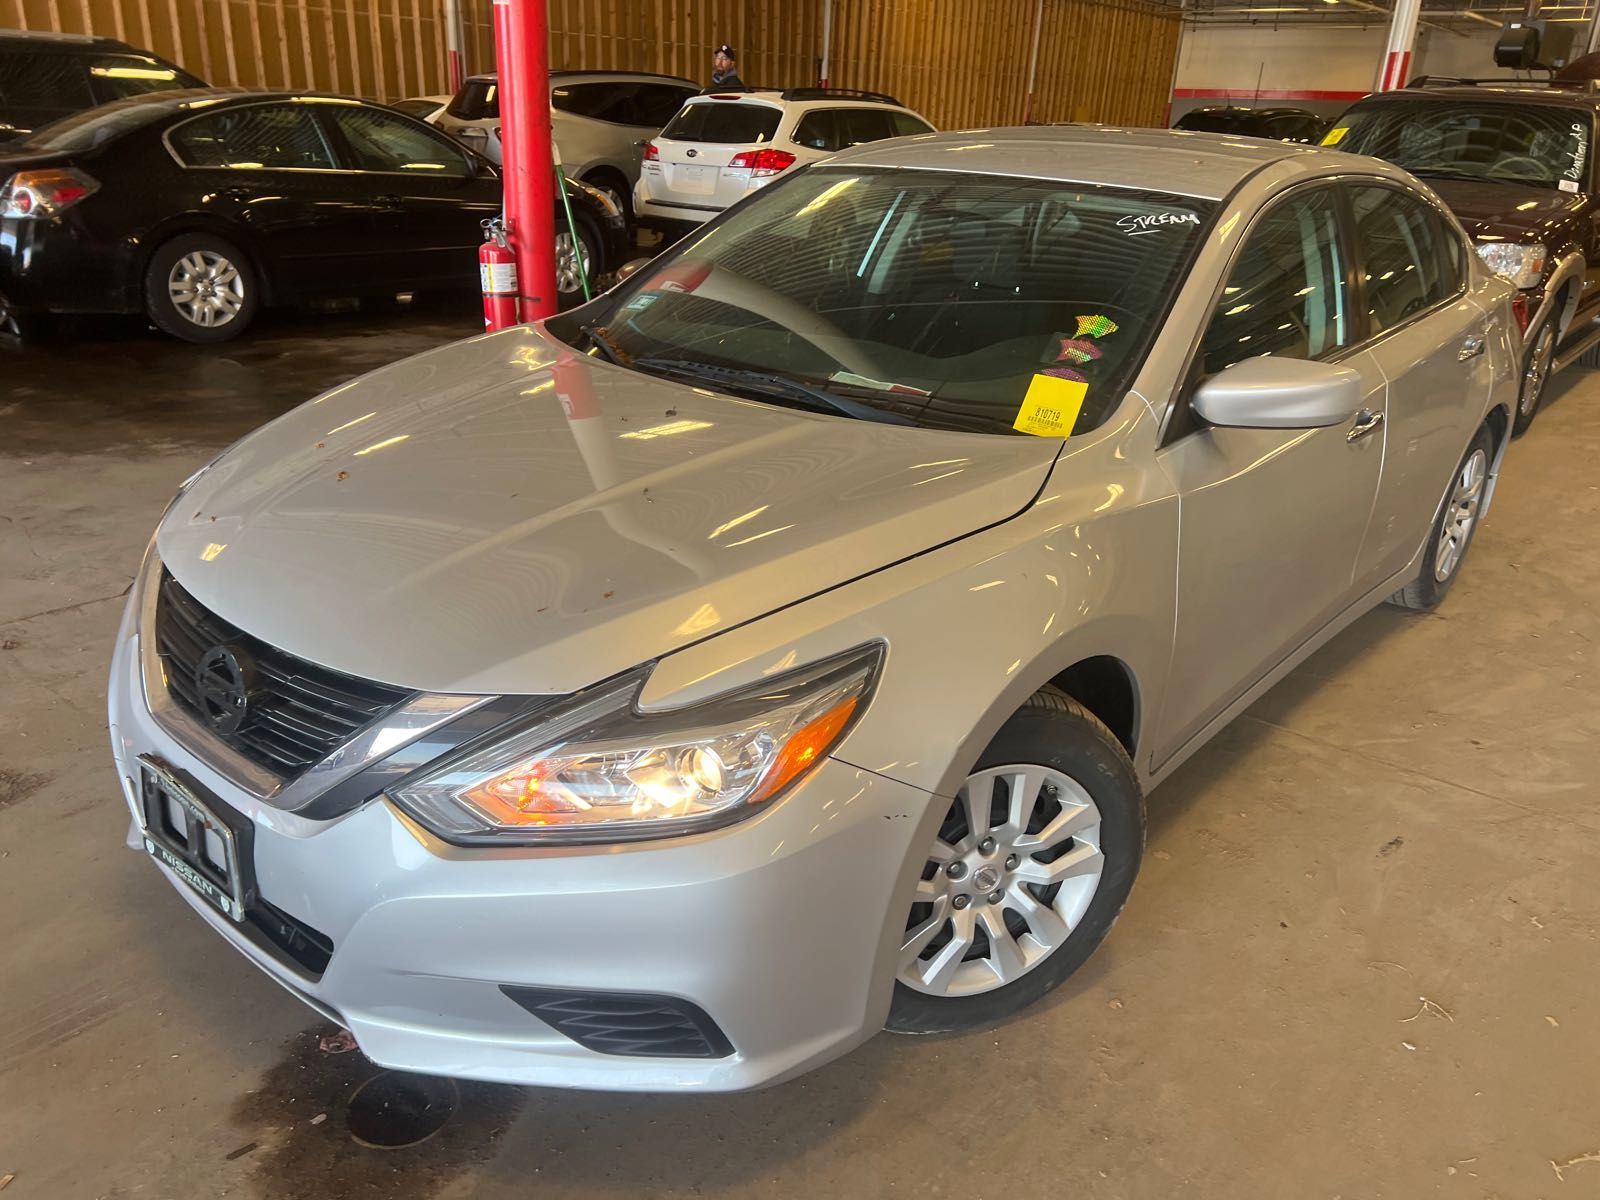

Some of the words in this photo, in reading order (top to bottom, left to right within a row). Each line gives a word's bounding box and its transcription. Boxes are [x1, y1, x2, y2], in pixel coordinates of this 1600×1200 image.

[1116, 212, 1200, 232] STREAM
[1035, 407, 1061, 422] 810719
[162, 850, 213, 895] NISSAN
